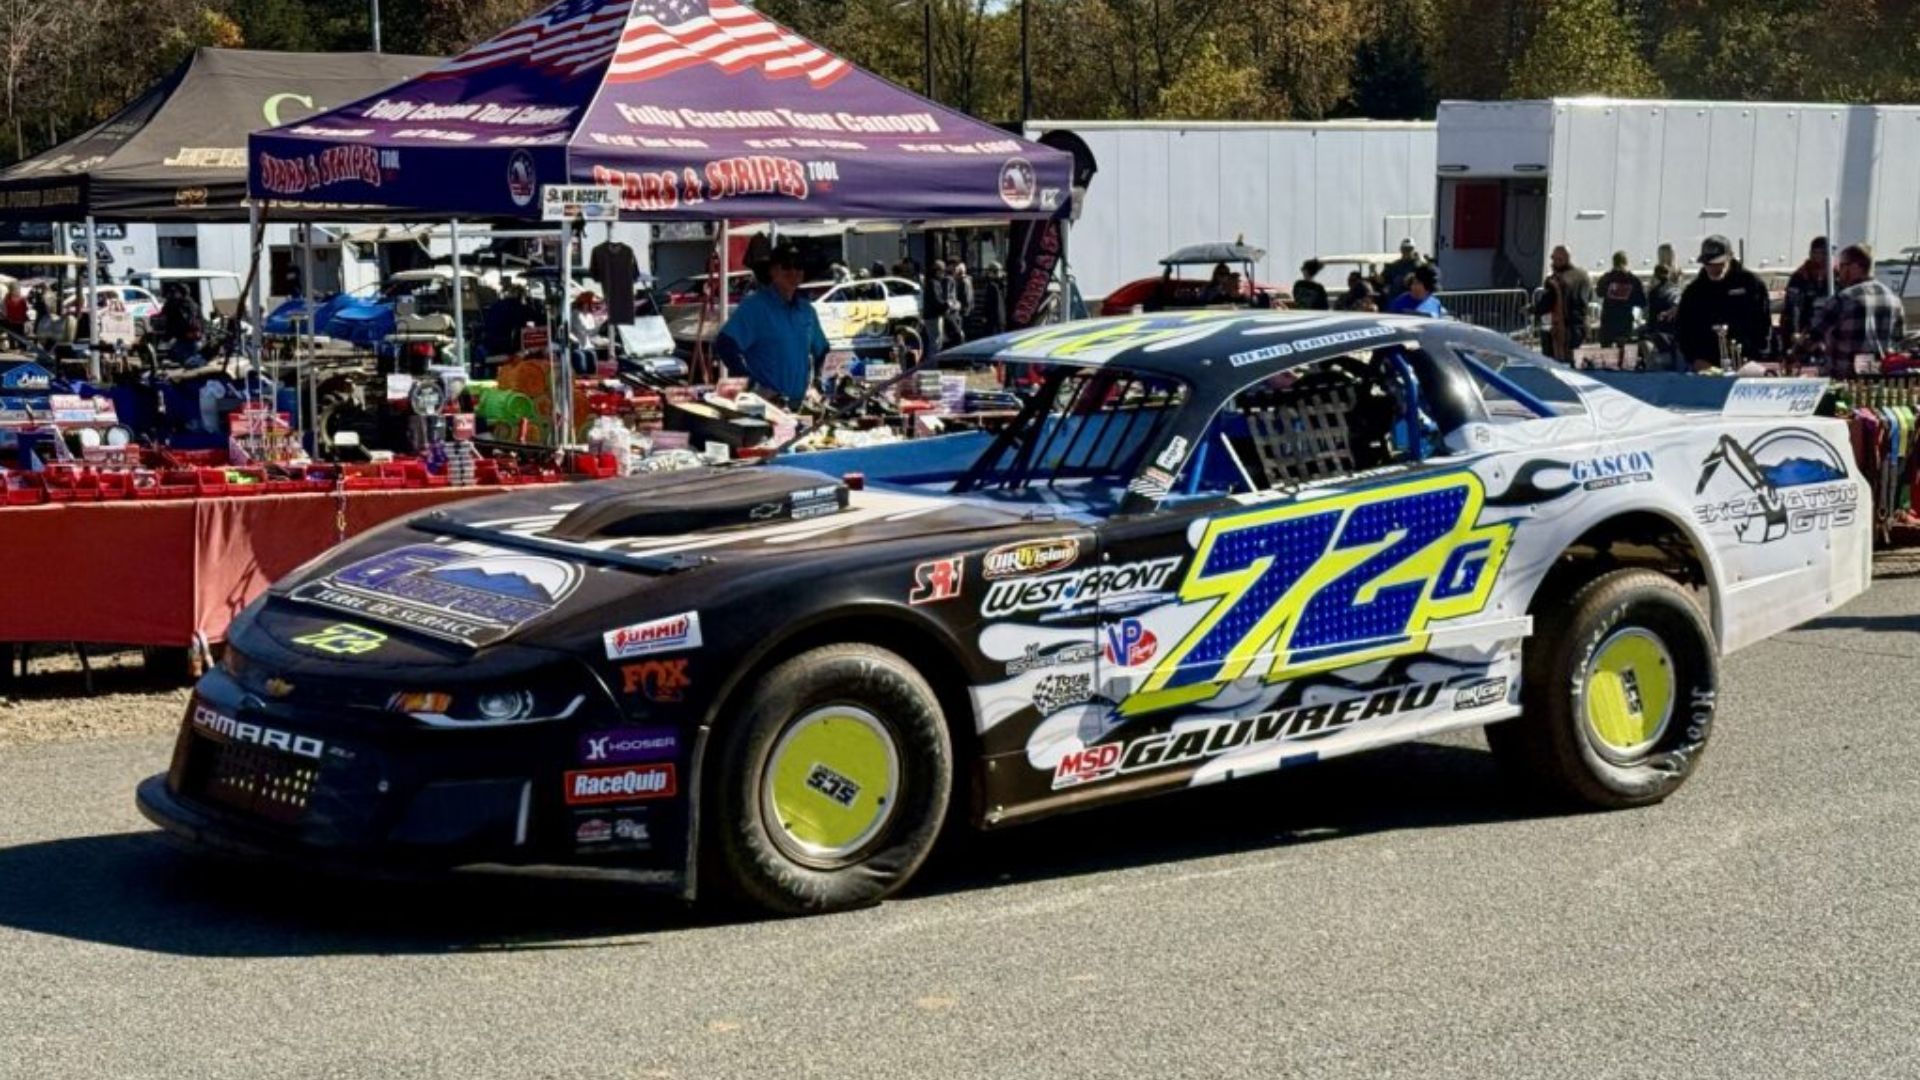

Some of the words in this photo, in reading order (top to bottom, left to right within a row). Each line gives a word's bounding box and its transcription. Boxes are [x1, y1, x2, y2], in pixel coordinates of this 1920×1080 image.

[614, 102, 686, 128] Fully
[679, 107, 788, 128] Custom
[836, 112, 941, 133] Canopy
[319, 144, 381, 188] STRIPES
[684, 167, 703, 205] &
[705, 156, 809, 200] STRIPES
[807, 161, 839, 181] TOOL
[1572, 450, 1654, 480] GASCON
[1790, 504, 1858, 534] GTS
[984, 580, 1069, 614] WEST
[1076, 560, 1177, 594] FRONT
[367, 600, 396, 618] DE
[396, 605, 482, 637] SURFACE
[1107, 617, 1143, 667] VP
[620, 658, 691, 702] FOX
[193, 706, 325, 758] CAMARO
[608, 736, 675, 751] HOOSIER
[1058, 744, 1122, 778] MSD
[1120, 681, 1444, 772] GAUVREAU
[574, 769, 668, 797] RaceQuip
